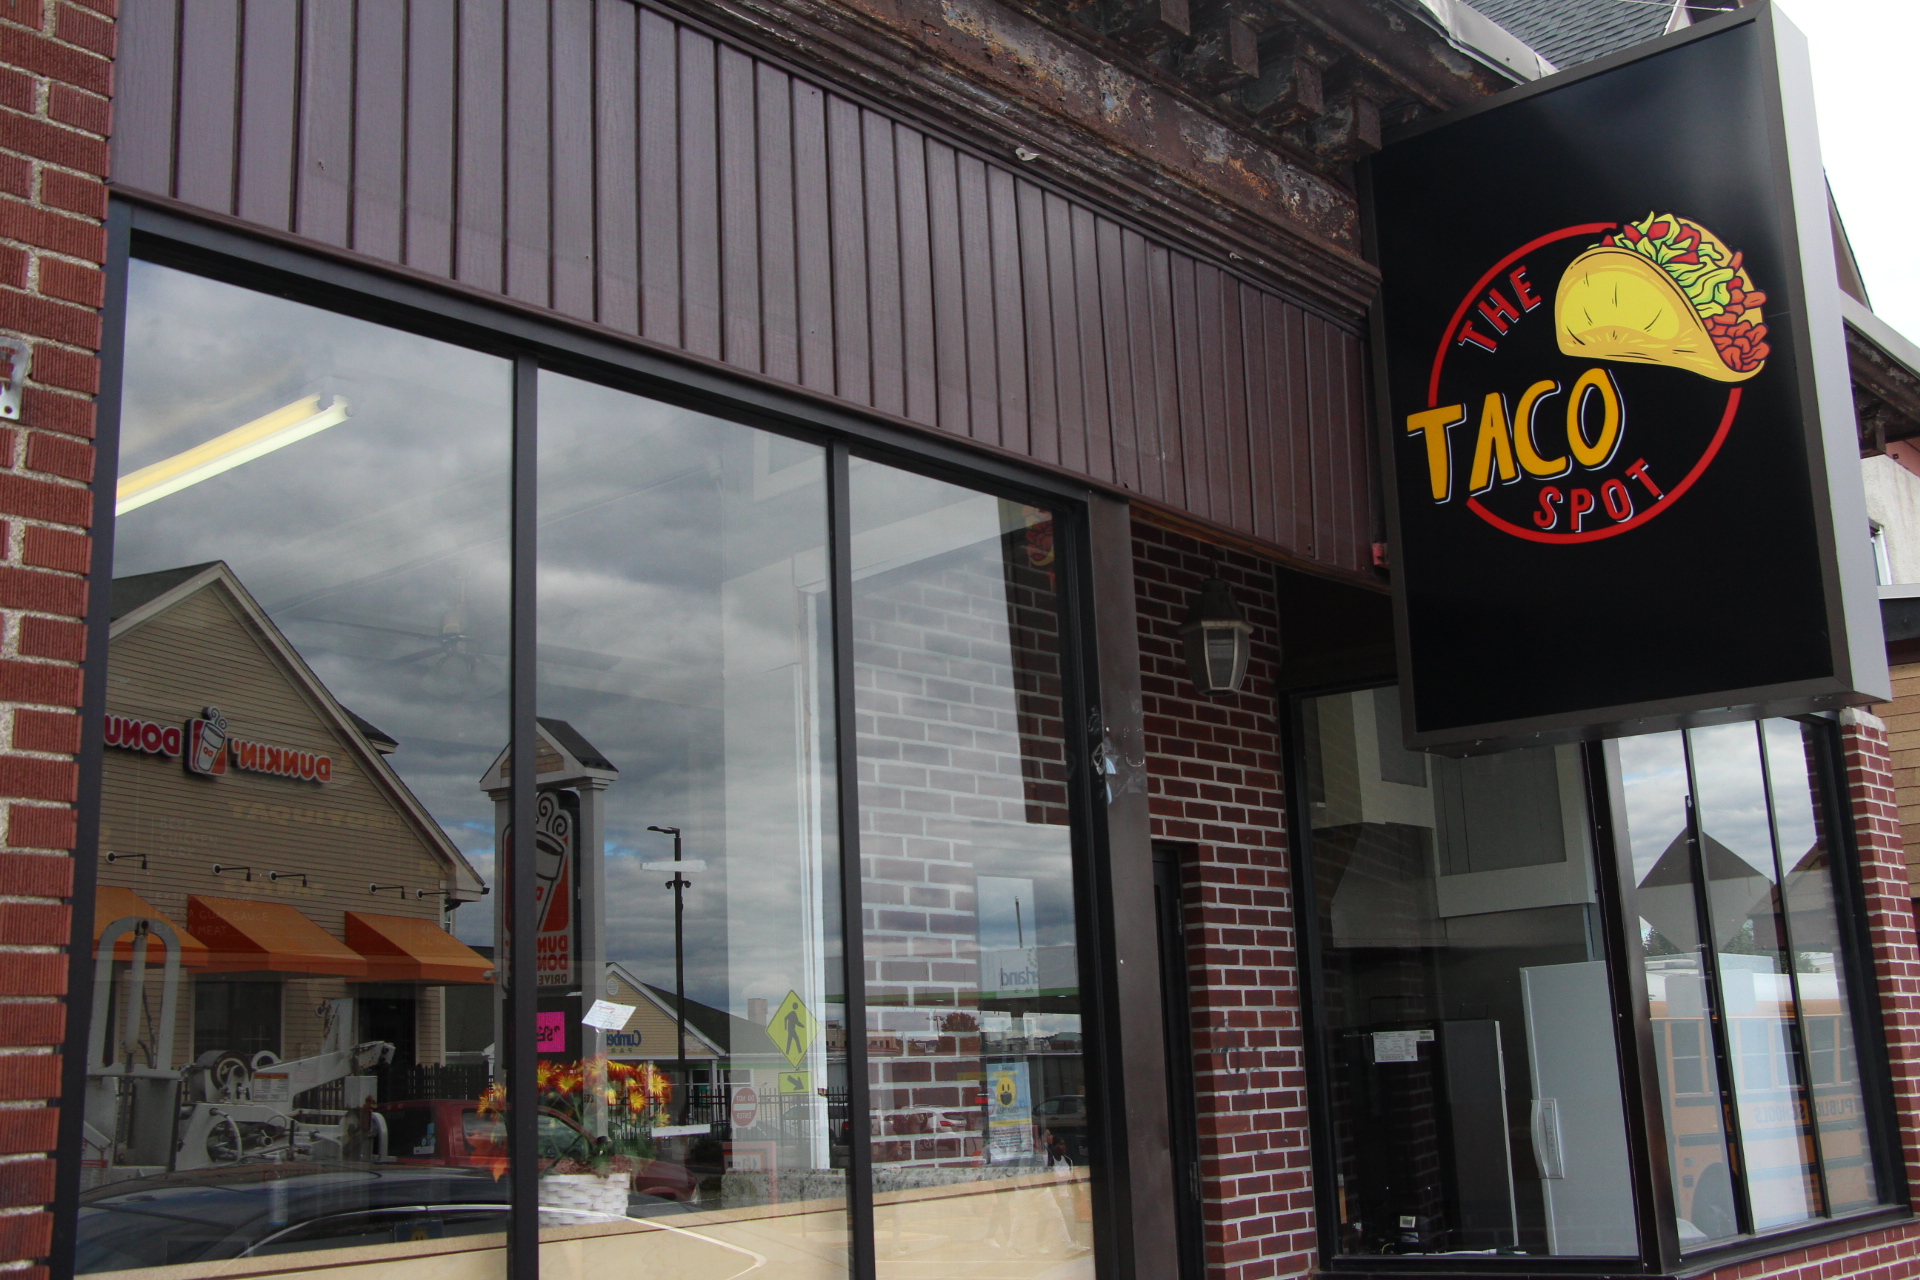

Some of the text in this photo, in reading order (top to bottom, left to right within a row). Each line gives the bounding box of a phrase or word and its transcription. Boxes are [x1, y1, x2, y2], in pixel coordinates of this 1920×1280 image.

[1457, 265, 1541, 353] THE
[1406, 367, 1625, 504] TACO
[1533, 457, 1664, 533] SPOT
